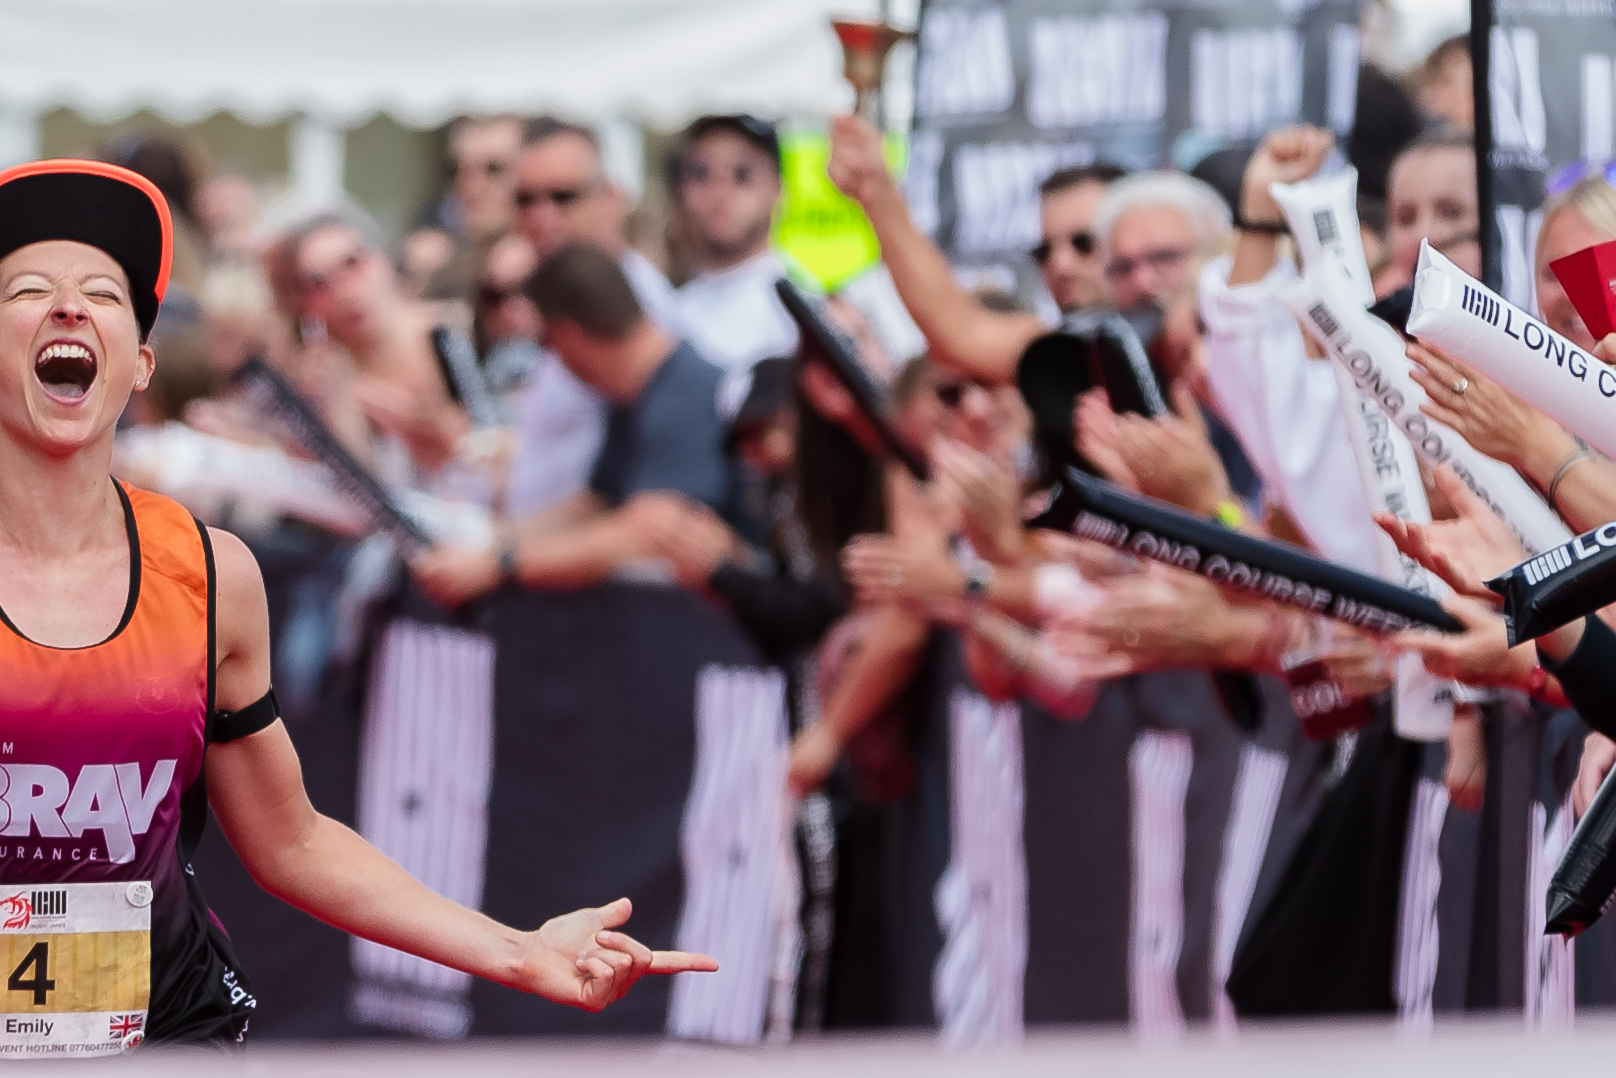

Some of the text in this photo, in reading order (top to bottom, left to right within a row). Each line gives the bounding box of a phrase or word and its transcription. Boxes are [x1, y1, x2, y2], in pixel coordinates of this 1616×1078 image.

[1336, 333, 1404, 412] LONG
[1503, 309, 1588, 382] LONG
[1116, 523, 1201, 569] LONG
[1204, 555, 1333, 611] COURSE
[8, 942, 55, 1005] 4
[5, 1018, 55, 1036] Emily
[26, 1043, 68, 1053] HOTLINE
